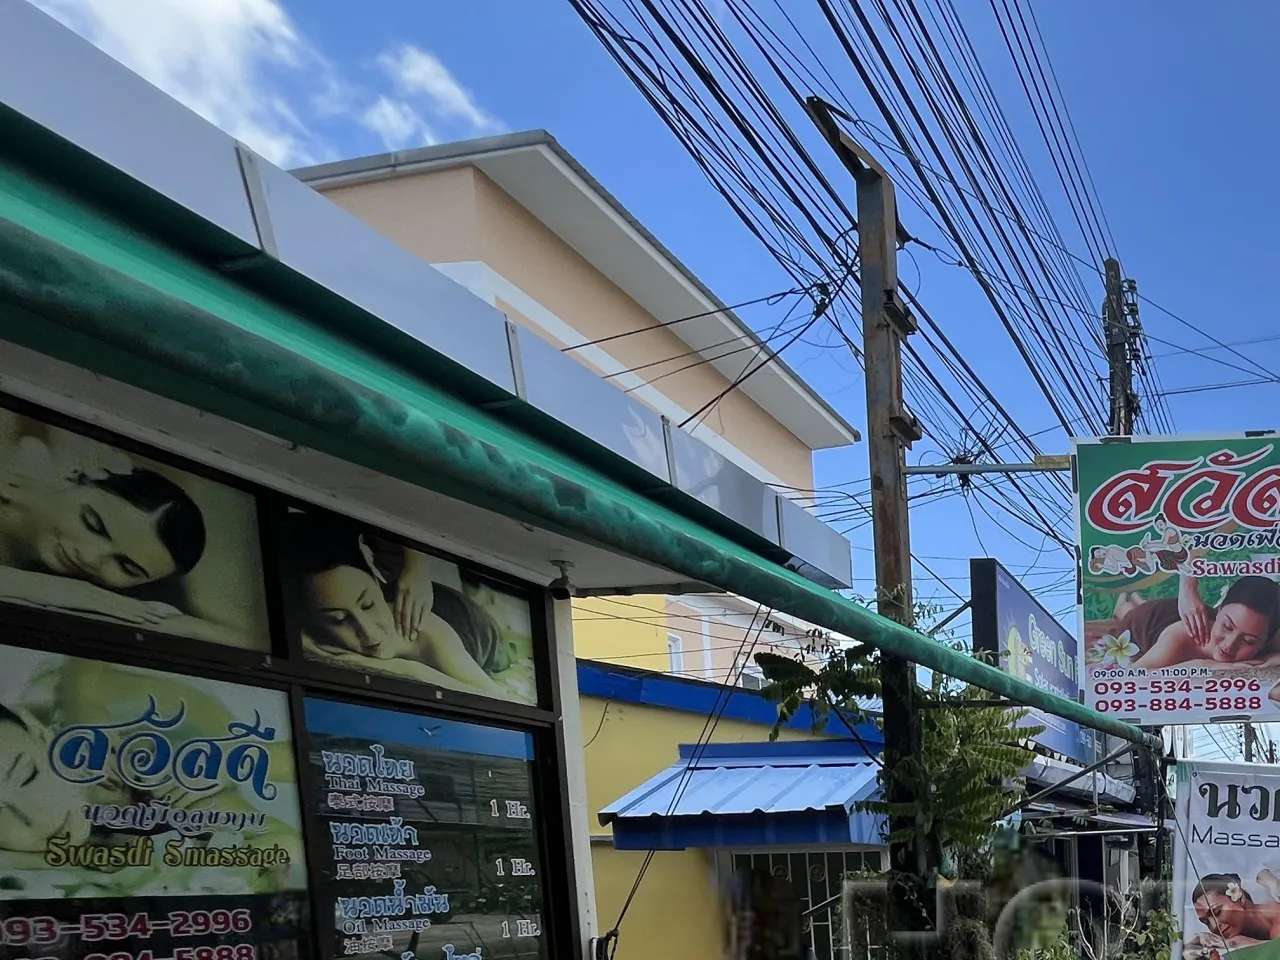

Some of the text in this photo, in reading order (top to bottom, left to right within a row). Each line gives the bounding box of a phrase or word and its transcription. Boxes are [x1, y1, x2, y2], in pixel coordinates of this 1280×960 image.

[1028, 613, 1057, 667] Green
[1093, 670, 1124, 679] 09:00
[1127, 669, 1149, 678] A.M.
[1161, 668, 1187, 677] 11:00
[1190, 667, 1211, 677] P.M.
[1094, 679, 1261, 695] 093-534-2996
[1095, 697, 1262, 712] 093-884-5888
[322, 744, 415, 780] นวดไทย
[326, 774, 425, 798] Thai Massage
[490, 799, 531, 819] 1 Hr.
[330, 817, 419, 845] นวดเท้า
[333, 845, 432, 863] Foot Massage
[336, 863, 401, 880] 足部按摩
[496, 858, 536, 876] 1 Hr.
[338, 879, 450, 917] นวดน้ำมัน
[0, 908, 251, 946] 93-534-2996
[343, 918, 430, 935] Oil Massage
[502, 919, 541, 938] 1 Hr.
